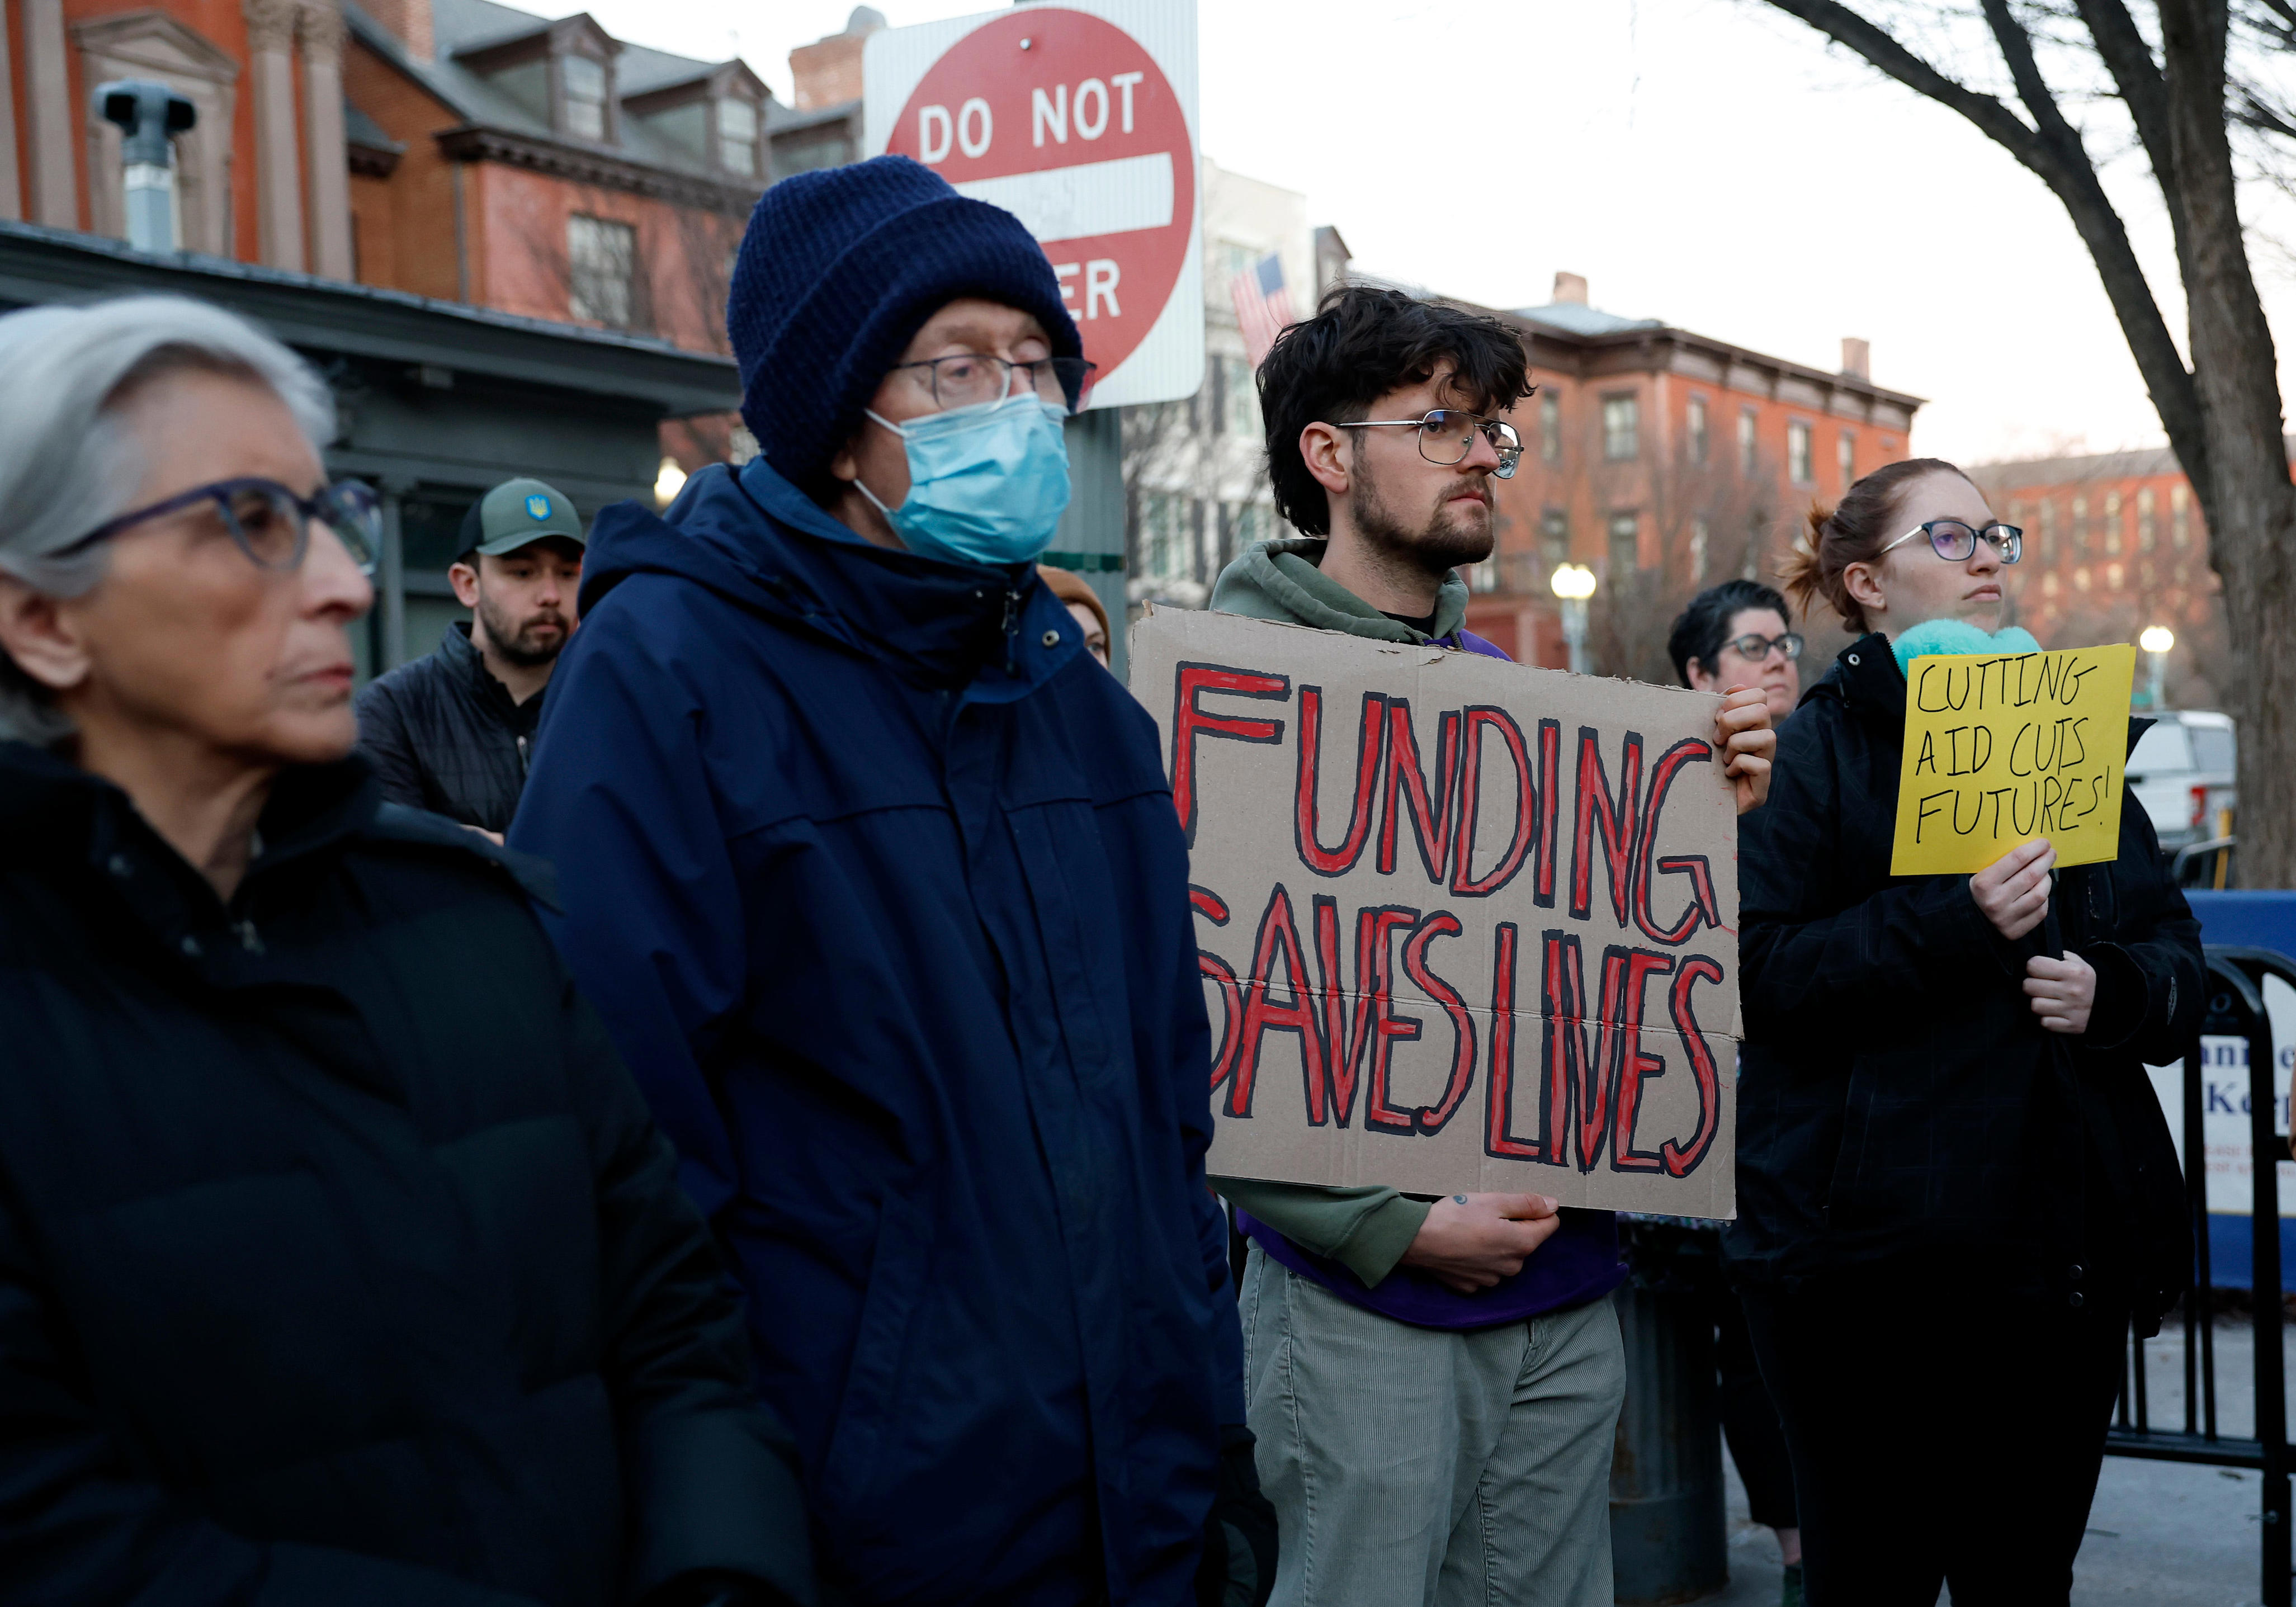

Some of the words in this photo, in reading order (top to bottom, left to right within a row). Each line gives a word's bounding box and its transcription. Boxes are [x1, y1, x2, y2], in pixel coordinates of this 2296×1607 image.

[918, 97, 993, 163] DO
[1032, 71, 1144, 147] NOT
[1917, 653, 2098, 712] CUTTING
[1915, 725, 1992, 776] AID
[2010, 717, 2089, 777] CUTS
[1170, 661, 1721, 945] FUNDING
[1916, 765, 2110, 844] FUTURES!
[1485, 921, 1723, 1178] LIVES
